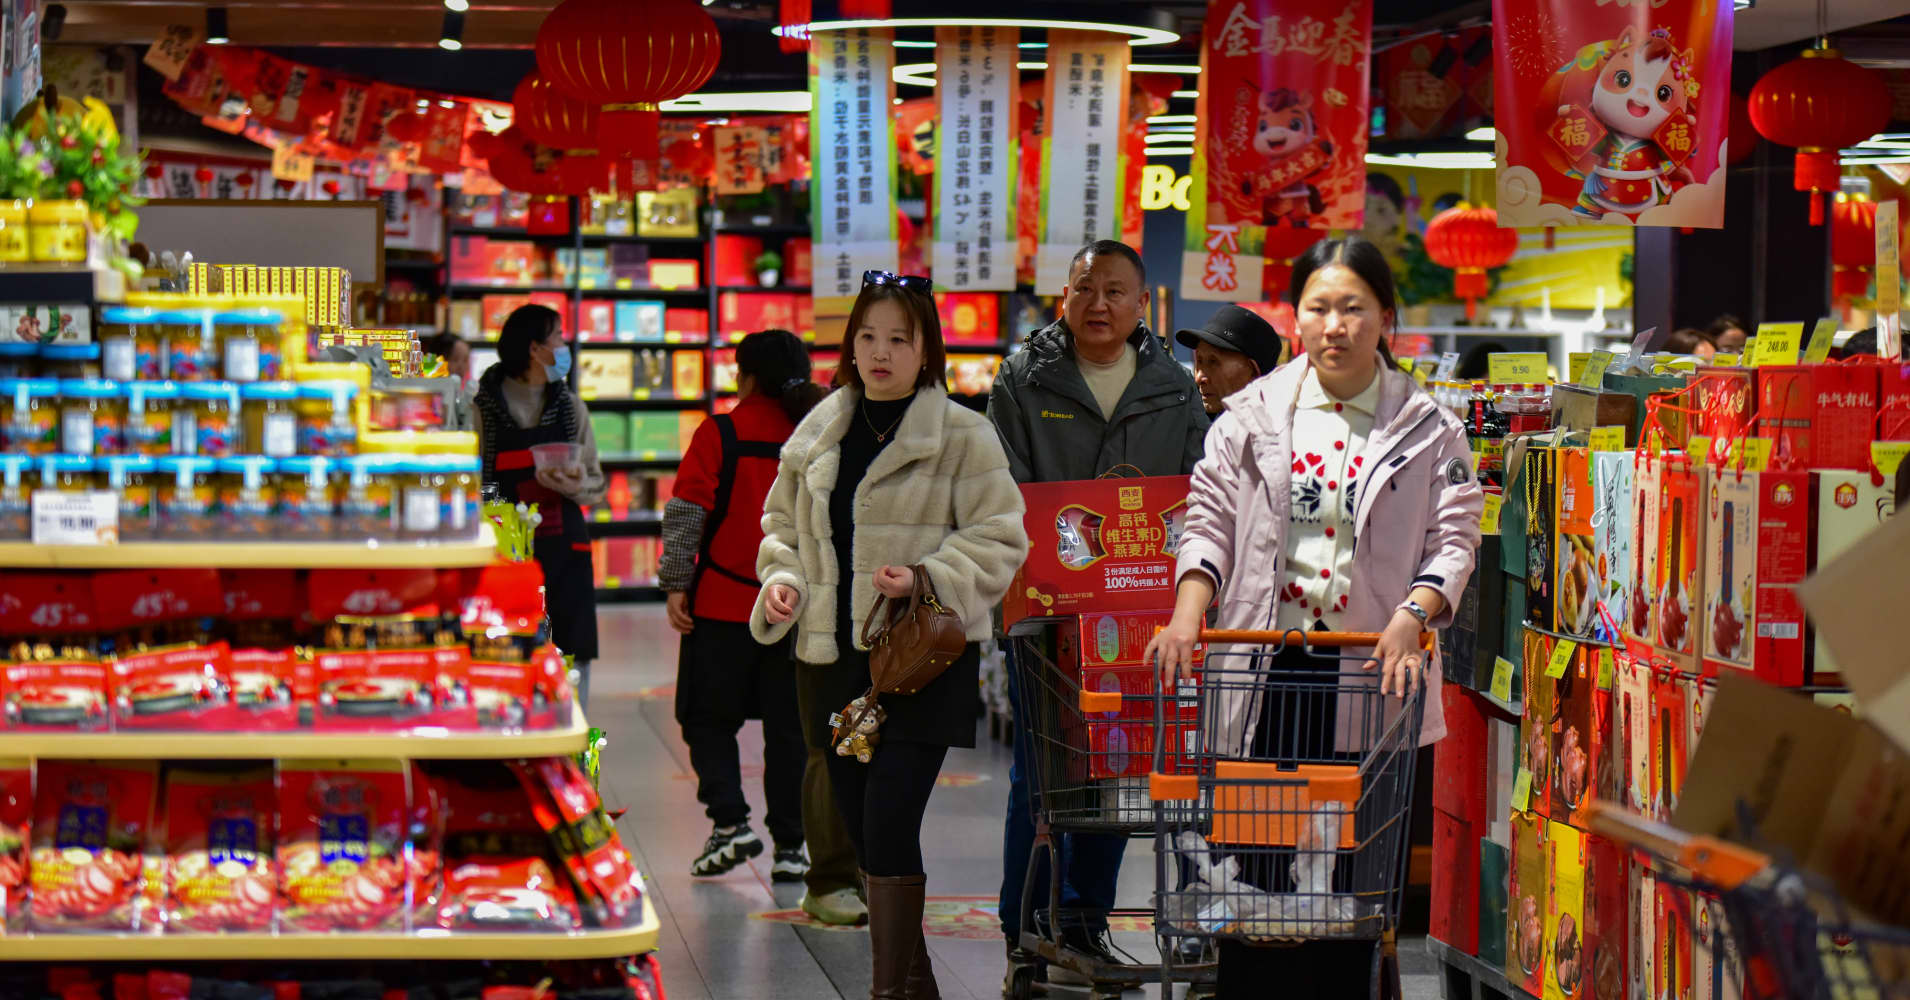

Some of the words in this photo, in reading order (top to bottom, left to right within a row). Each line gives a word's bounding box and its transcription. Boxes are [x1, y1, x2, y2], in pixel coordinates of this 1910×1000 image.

[1213, 2, 1366, 66] 金马迎春
[1560, 118, 1591, 147] 福
[1666, 122, 1692, 152] 福
[1257, 151, 1316, 191] 马年大吉
[1203, 224, 1240, 292] 大米
[1118, 512, 1148, 528] 高钙
[1106, 527, 1162, 544] 维生素D
[1113, 543, 1157, 558] 燕麦片
